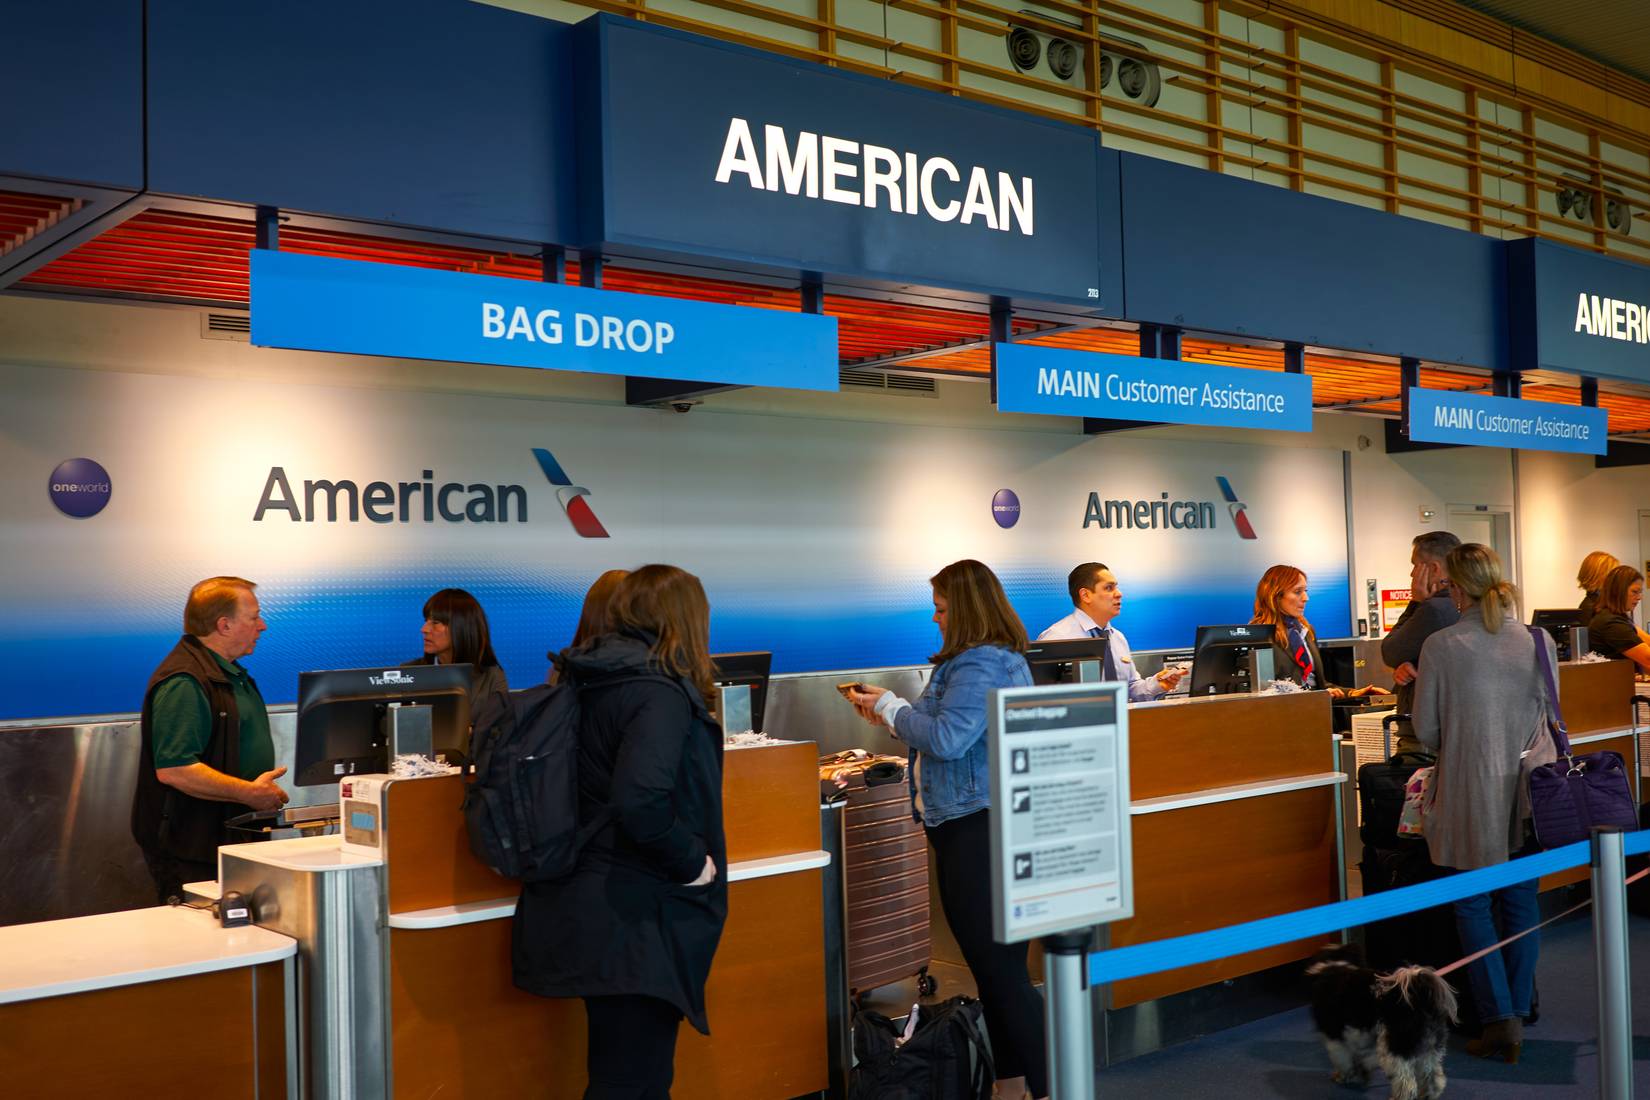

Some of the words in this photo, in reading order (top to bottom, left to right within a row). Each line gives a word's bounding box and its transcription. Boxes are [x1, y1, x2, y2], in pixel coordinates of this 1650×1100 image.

[714, 117, 1034, 236] AMERICAN
[482, 302, 563, 344] BAG
[575, 312, 675, 354] DROP
[1574, 292, 1650, 344] AMERI
[1037, 367, 1100, 399] MAIN
[1105, 374, 1198, 406] Customer
[1200, 382, 1285, 413] Assistance
[1434, 405, 1473, 430] MAIN
[1476, 410, 1534, 435] Customer
[1535, 416, 1590, 440] Assistance
[53, 482, 109, 493] oneworld
[253, 466, 528, 524] American
[1082, 491, 1216, 529] American
